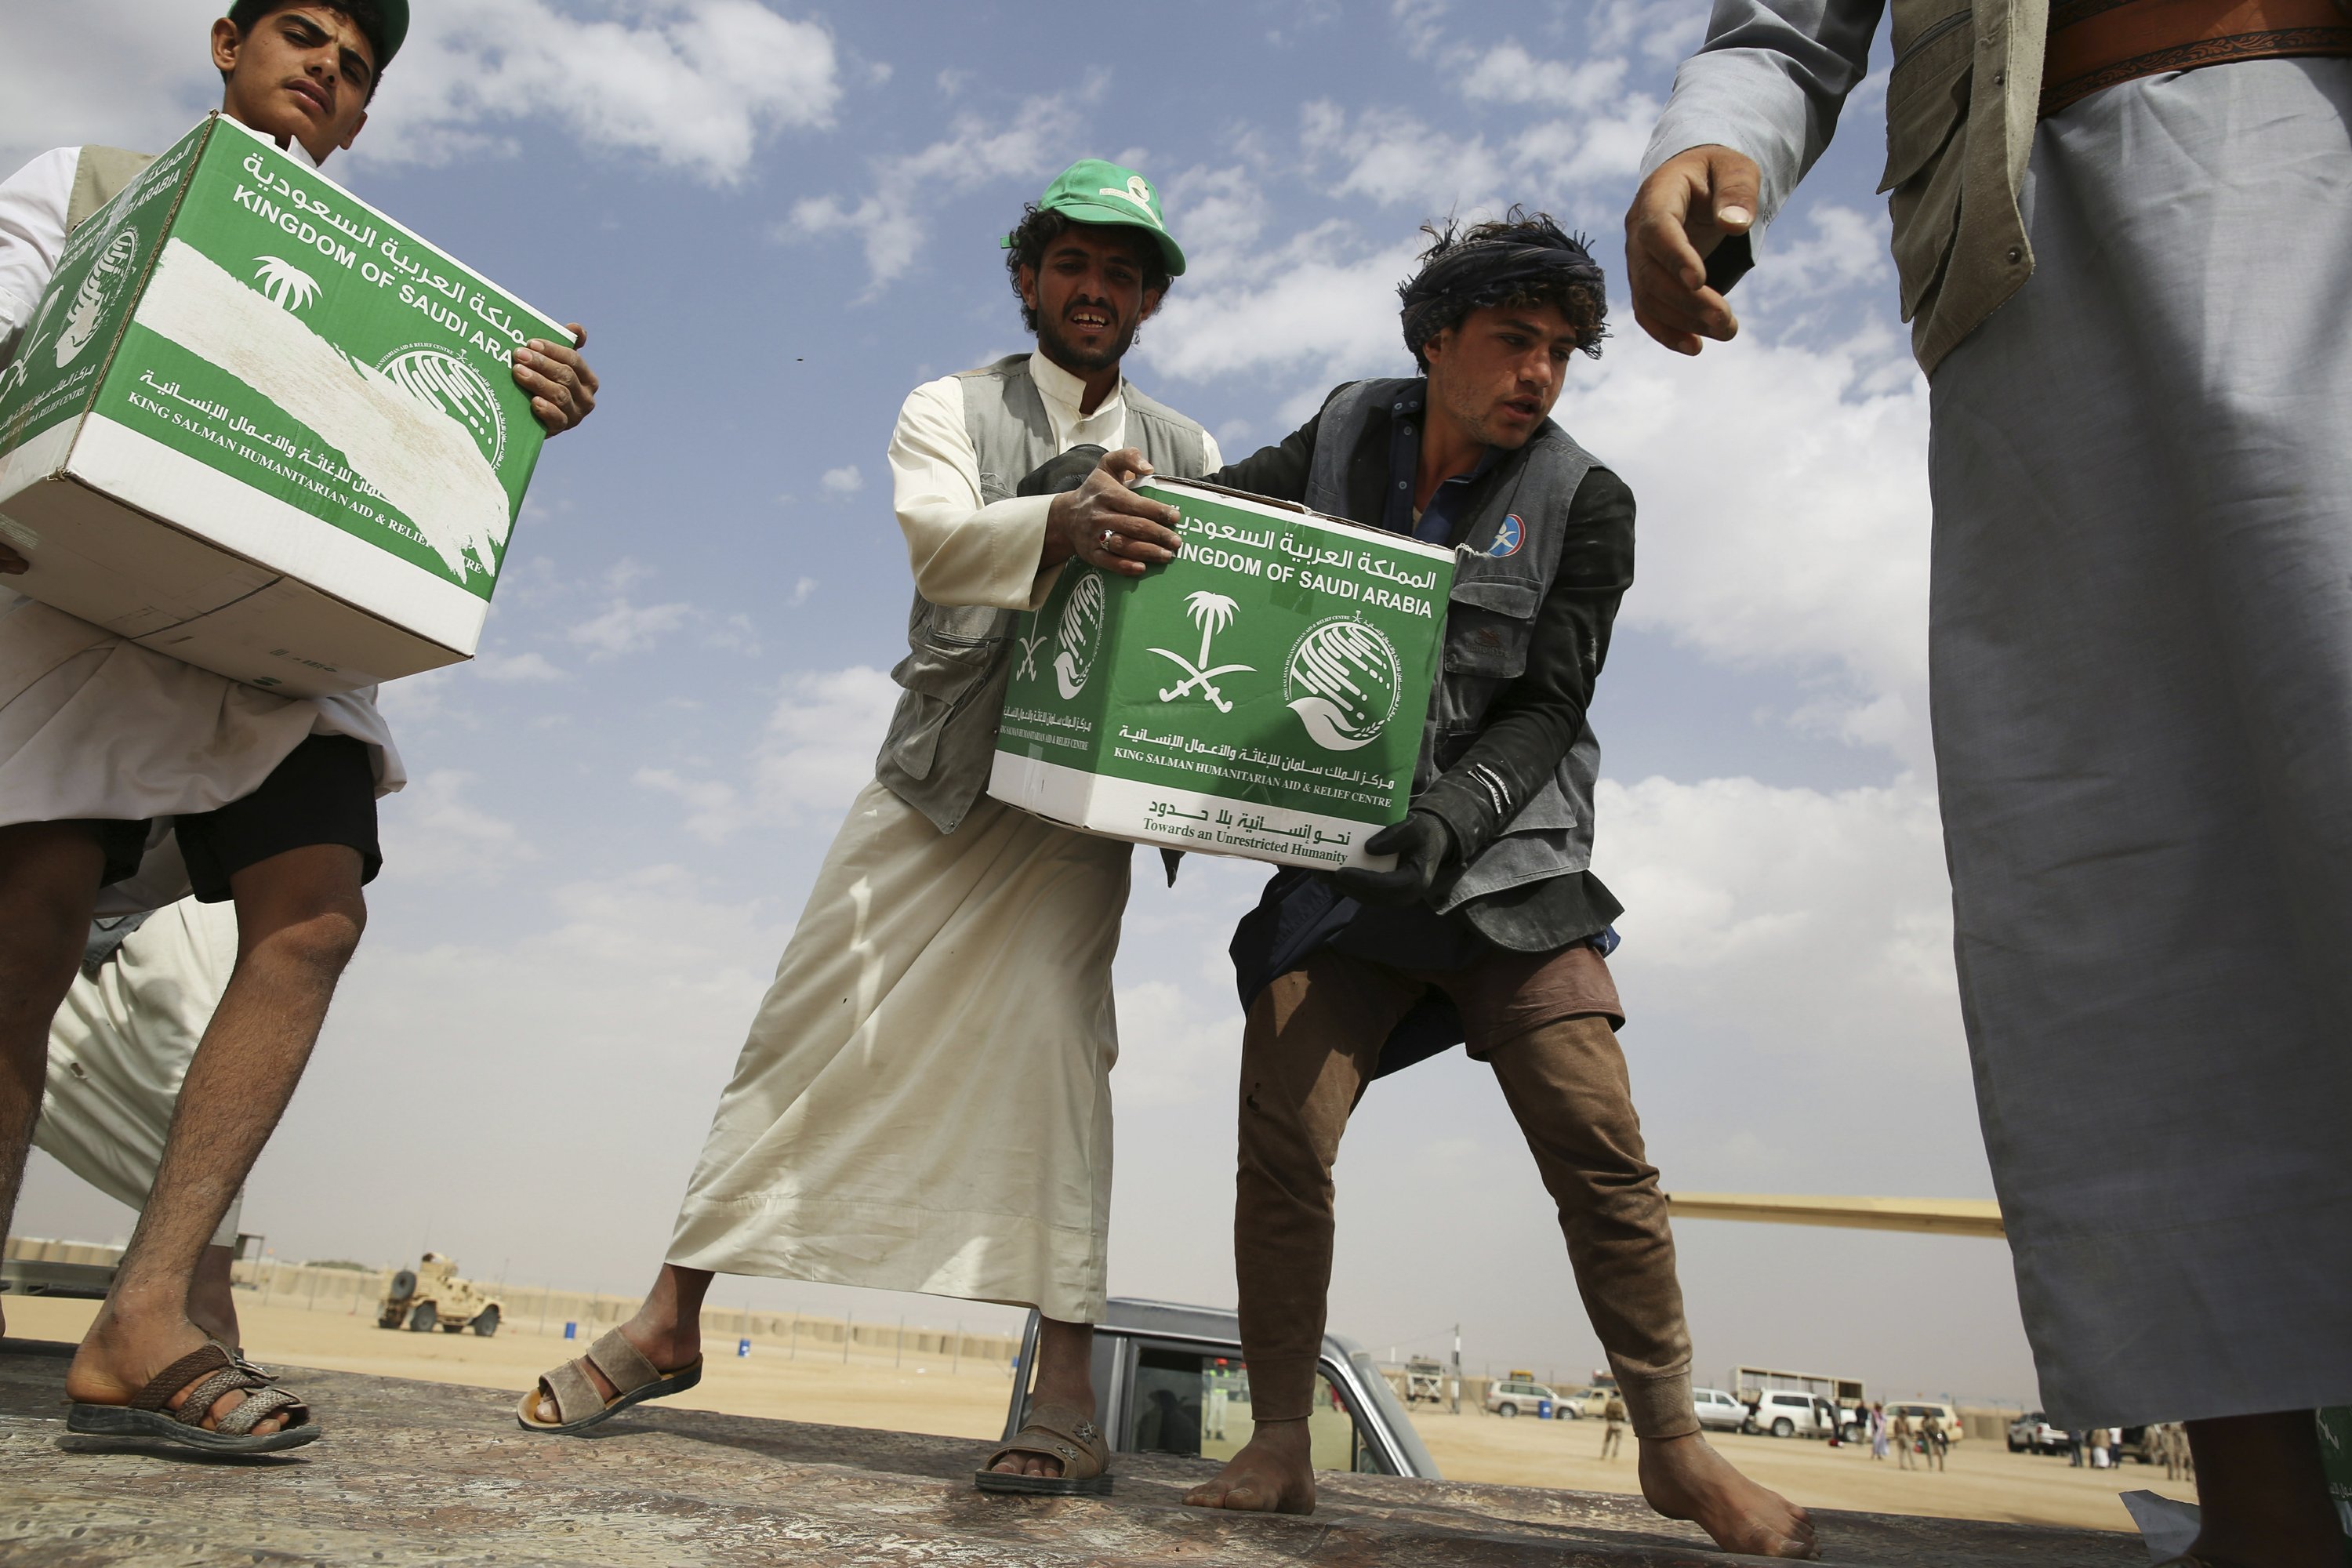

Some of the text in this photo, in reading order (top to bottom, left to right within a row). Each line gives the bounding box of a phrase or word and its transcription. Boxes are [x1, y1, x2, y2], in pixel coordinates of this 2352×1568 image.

[136, 169, 181, 207] ARABIA
[243, 152, 528, 347] ملكة العربية السعودية
[233, 183, 513, 368] KINGDOM OF SAUDI ARA
[376, 346, 401, 369] MANITARIAN
[60, 385, 88, 406] CENTRE
[140, 368, 229, 420] الإنسانية
[228, 416, 297, 459] والأعمال
[127, 391, 430, 547] KING SALMAN HUMANITARIAN AID & RELIE
[298, 447, 353, 484] للإغاثة
[1279, 532, 1353, 569] العربية
[1357, 551, 1437, 590] المملكة
[1174, 541, 1432, 619] INGDOM OF SAUDI ARABIA
[1285, 630, 1307, 666] HUMANITARIAN
[1316, 615, 1332, 626] RELIEF
[1070, 739, 1089, 750] CENTRE
[1118, 724, 1396, 789] مركز الملك سلمان للإغاثة والأعمال الإنسانية
[1113, 747, 1392, 808] KING SALMAN HUMANITARIAN AID & RELIEF CENTRE
[1143, 818, 1348, 866] Towards an Unrestricted Humanity
[1149, 800, 1352, 846] نحو إنسانية بلا حدود
